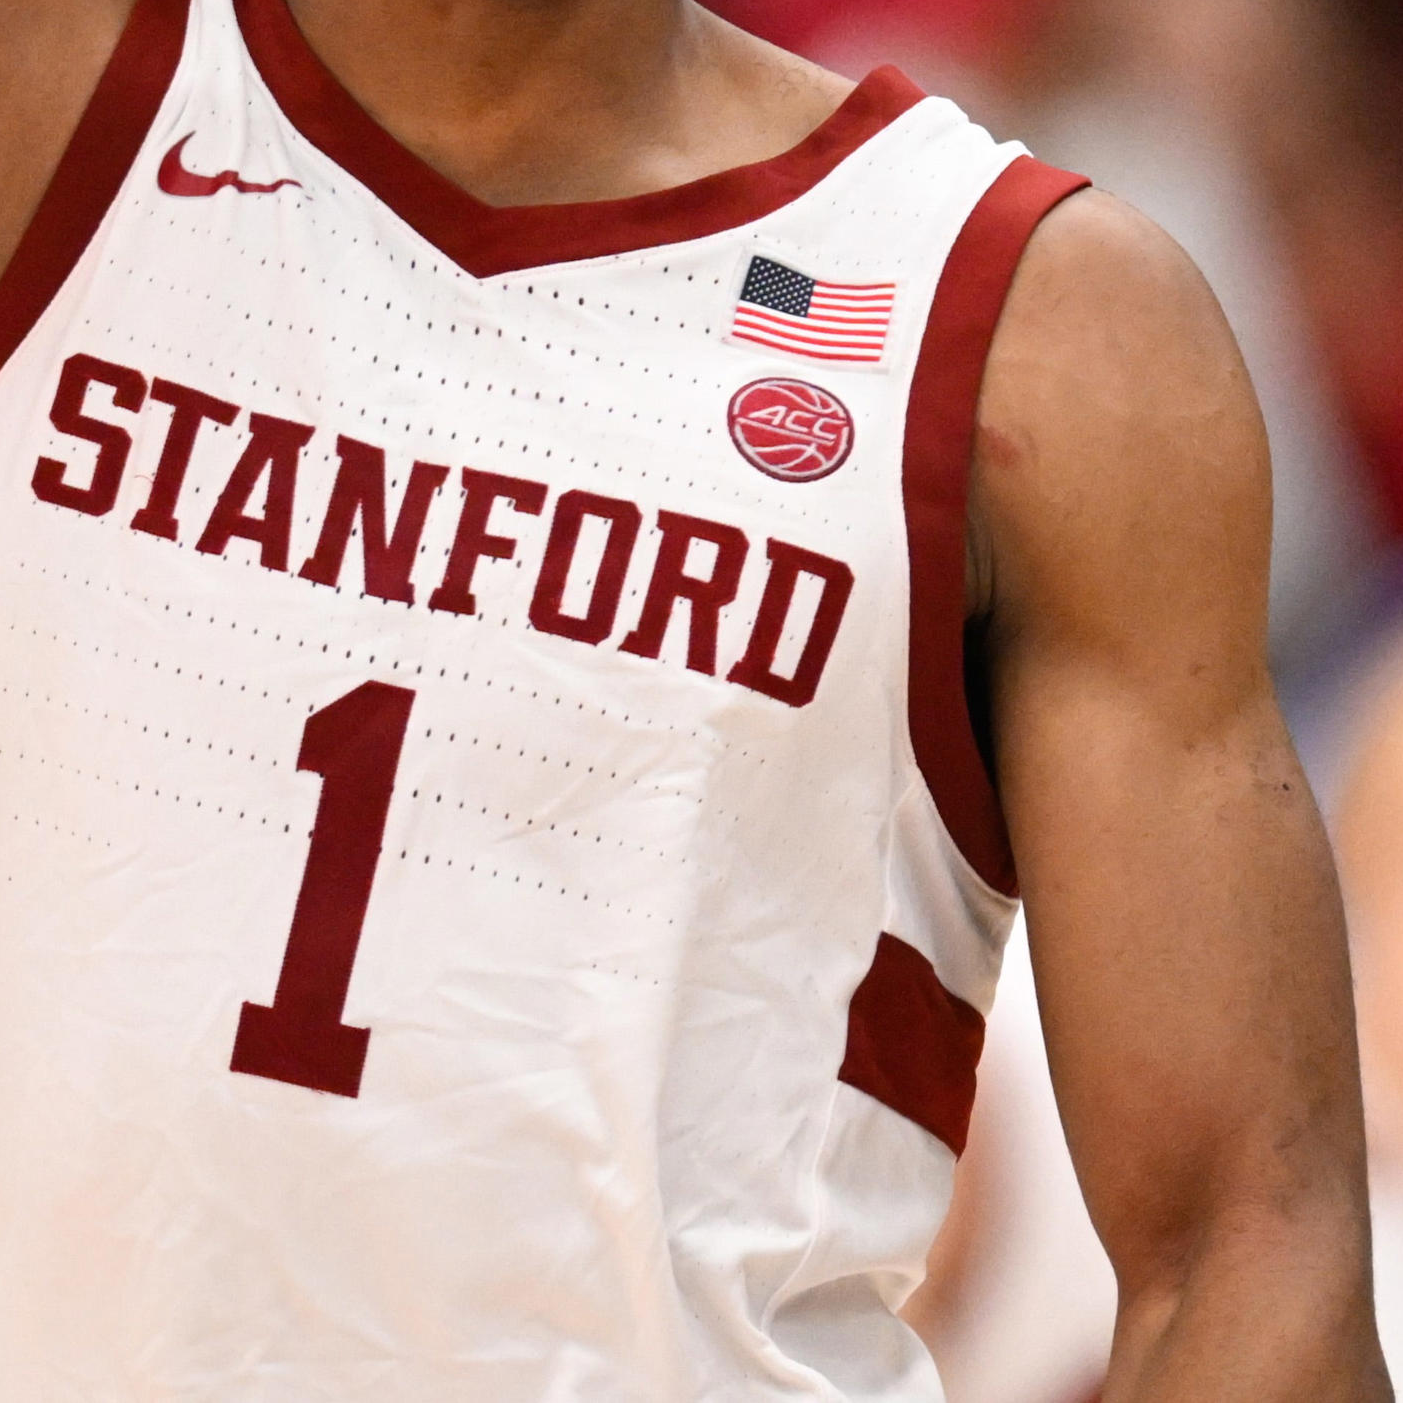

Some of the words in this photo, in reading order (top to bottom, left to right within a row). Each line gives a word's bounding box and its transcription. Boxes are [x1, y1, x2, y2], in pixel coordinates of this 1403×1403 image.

[31, 353, 855, 708] STANFORD
[749, 405, 846, 440] ACC
[229, 679, 416, 1099] 1
